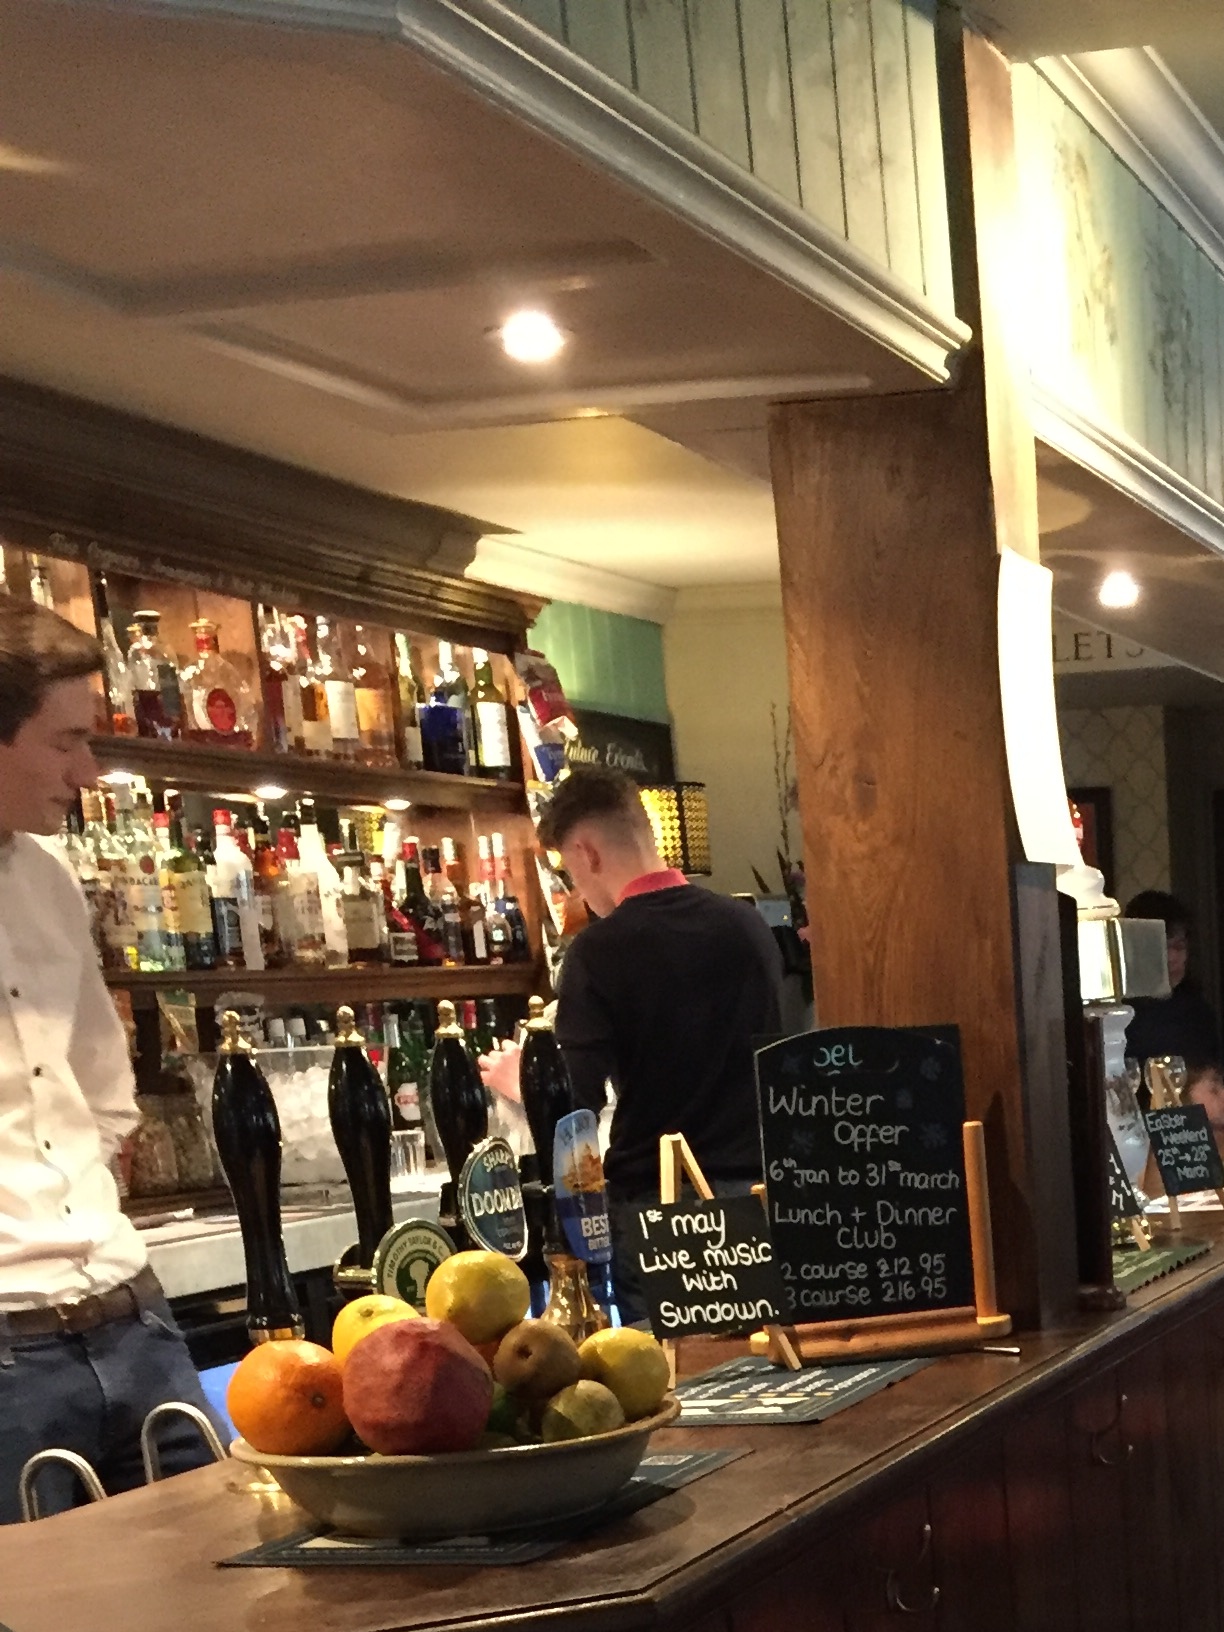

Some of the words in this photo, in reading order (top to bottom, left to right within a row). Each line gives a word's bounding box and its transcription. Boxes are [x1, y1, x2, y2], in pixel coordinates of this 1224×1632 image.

[768, 1083, 885, 1117] Winter
[1145, 1111, 1187, 1133] Easter
[834, 1120, 910, 1153] Offer
[838, 1166, 860, 1185] to
[581, 1213, 610, 1237] BEST
[774, 1201, 842, 1226] Lunch
[851, 1206, 867, 1223] +
[876, 1200, 957, 1226] Dinner
[836, 1225, 897, 1250] Club
[639, 1247, 696, 1273] Live
[780, 1262, 797, 1281] 2
[800, 1261, 869, 1280] course
[784, 1286, 797, 1309] 3
[800, 1285, 872, 1307] course
